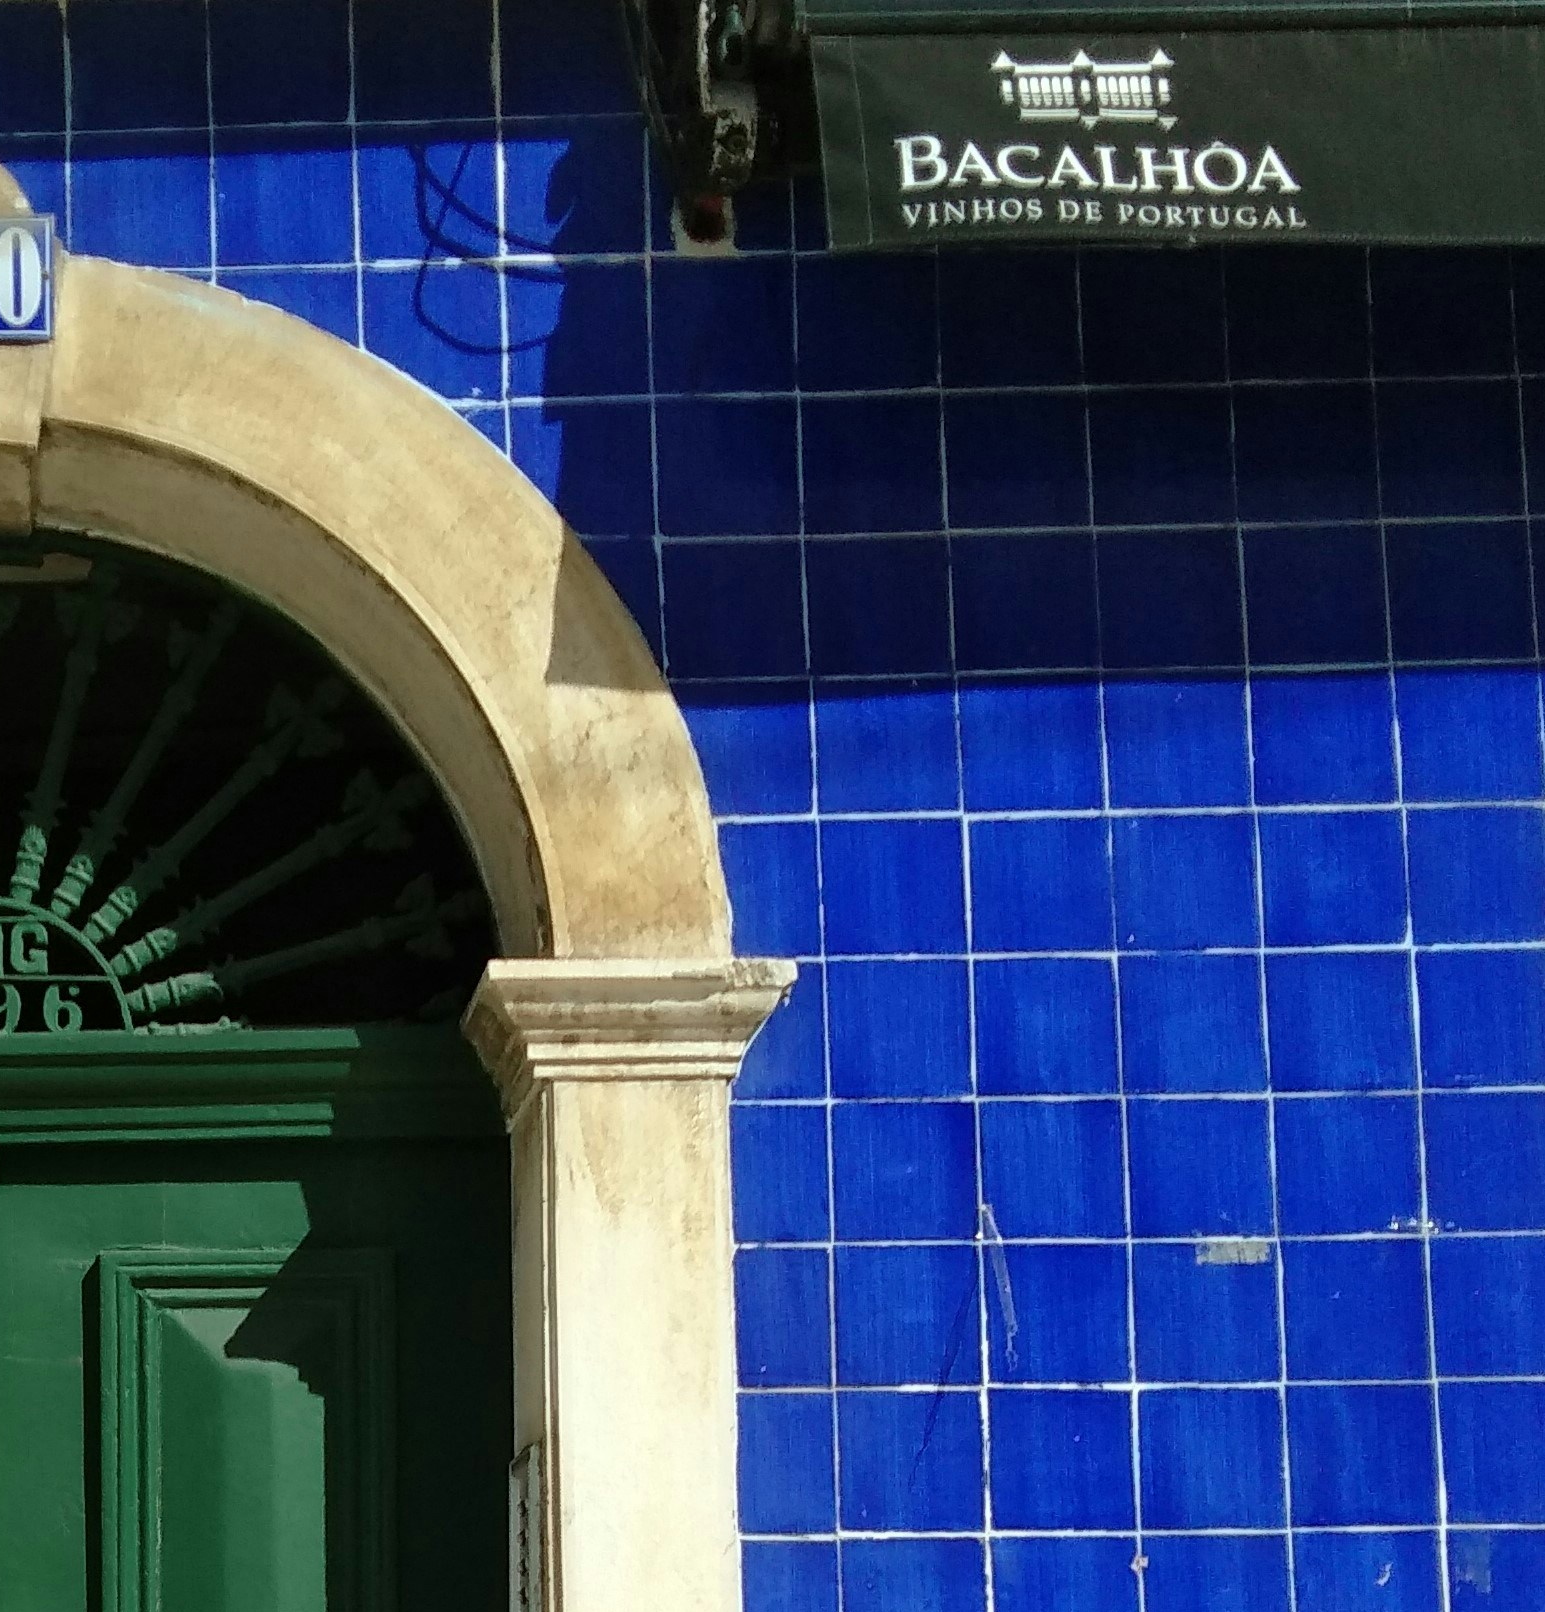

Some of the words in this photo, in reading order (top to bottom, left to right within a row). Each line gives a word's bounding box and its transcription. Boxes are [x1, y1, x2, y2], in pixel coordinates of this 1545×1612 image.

[893, 133, 1301, 194] BACALHÔA
[901, 197, 1044, 227] VINHOS
[1056, 199, 1104, 223] DE
[1117, 203, 1309, 229] PORTUGAL
